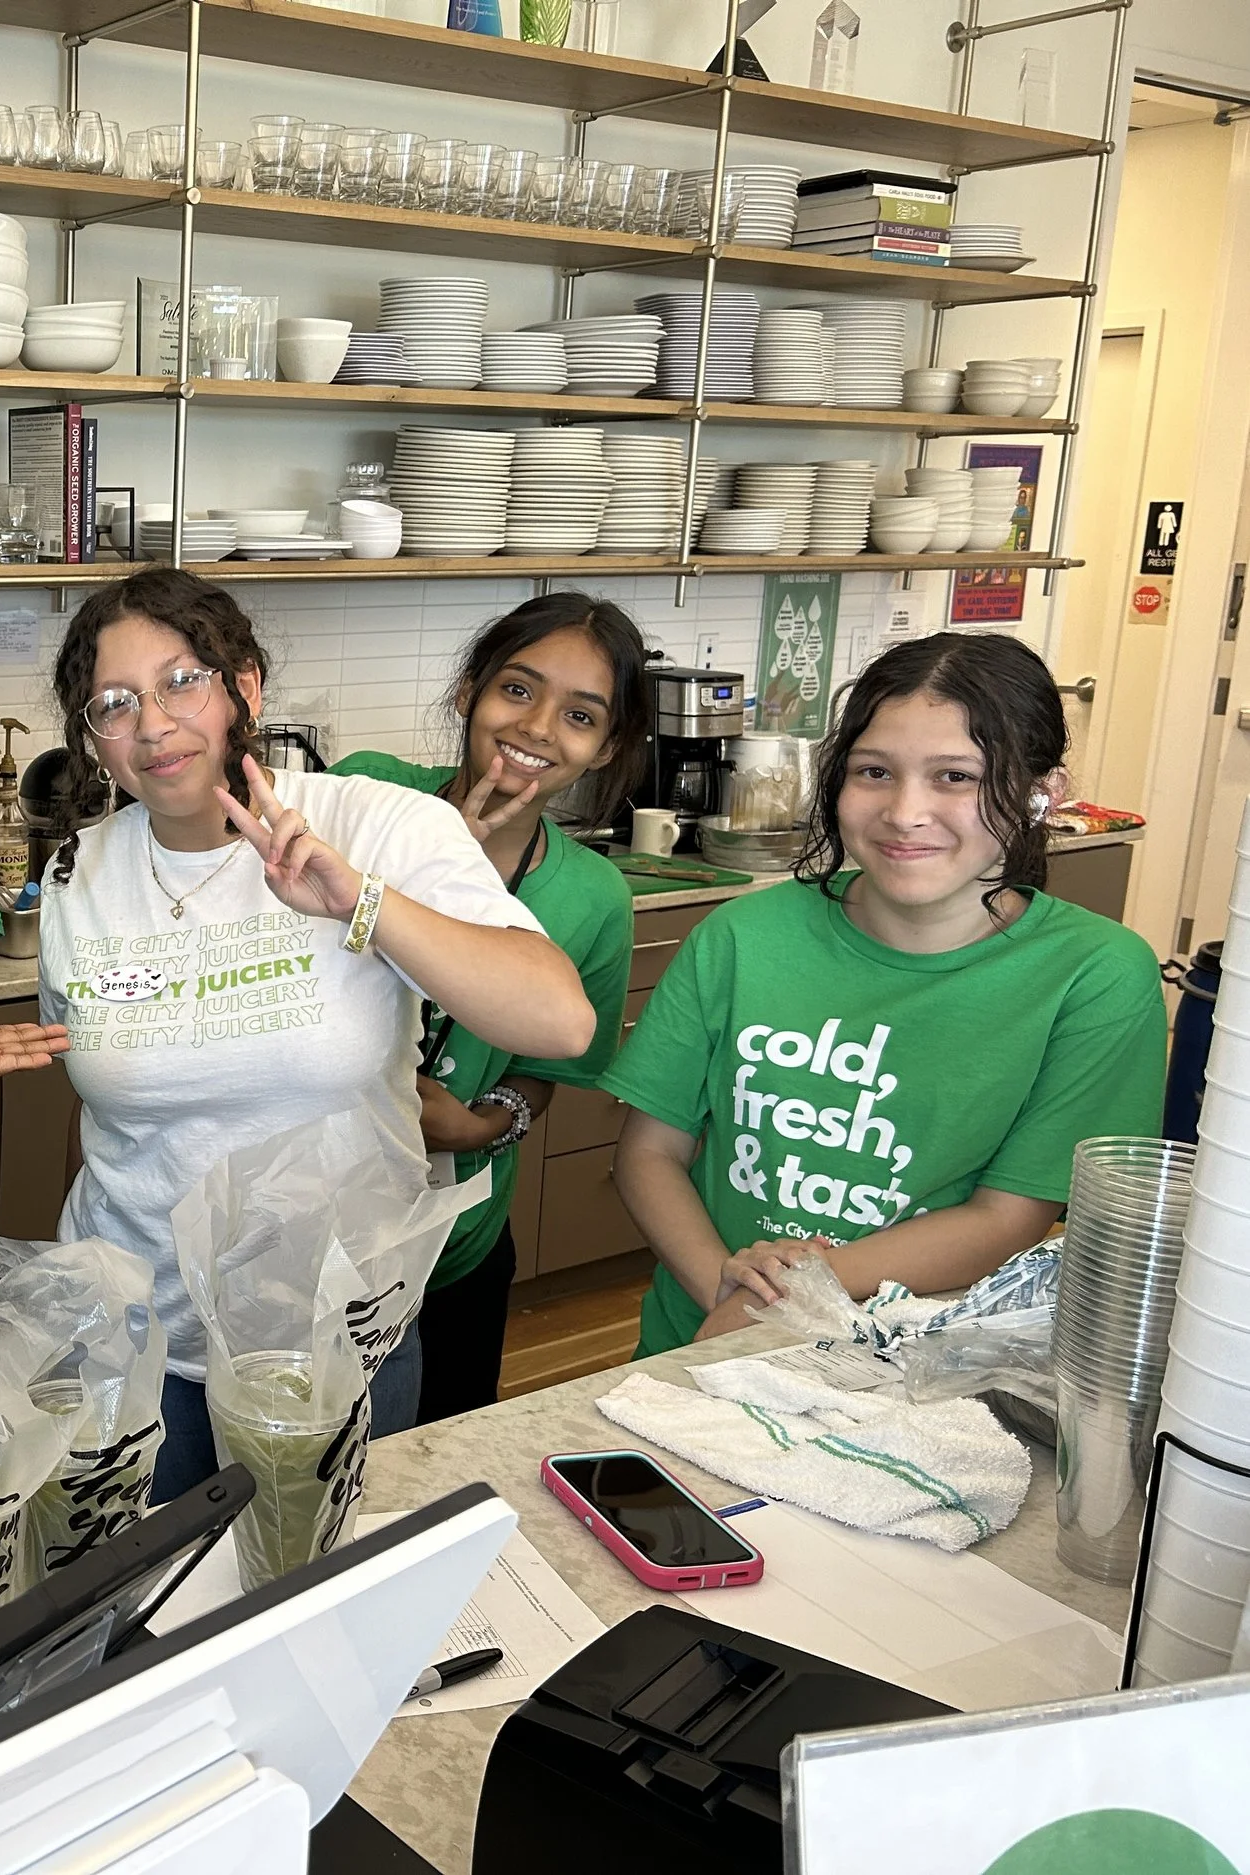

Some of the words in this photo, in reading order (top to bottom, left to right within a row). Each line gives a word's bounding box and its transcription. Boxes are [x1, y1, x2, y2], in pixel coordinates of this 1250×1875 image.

[894, 226, 915, 236] HEART
[924, 230, 942, 239] PLATE
[71, 427, 80, 473] ORGANIC
[71, 476, 79, 501] SEED
[71, 504, 79, 545] GROWER
[1146, 549, 1163, 557] ALL
[1135, 594, 1159, 606] STOP
[75, 936, 124, 956] THE
[129, 930, 191, 954] CITY
[196, 911, 308, 951] JUICERY
[195, 929, 314, 976] JUICERY
[66, 981, 96, 999] TH
[195, 954, 315, 1000] JUICERY
[101, 978, 151, 991] Genesis
[115, 1002, 186, 1023] CITY
[192, 977, 319, 1022] JUICERY
[110, 1026, 183, 1049] CITY
[191, 1002, 324, 1048] JUICERY
[737, 1018, 898, 1101] cold,
[732, 1064, 913, 1174] fresh,
[728, 1134, 769, 1202] &
[785, 1221, 812, 1240] City
